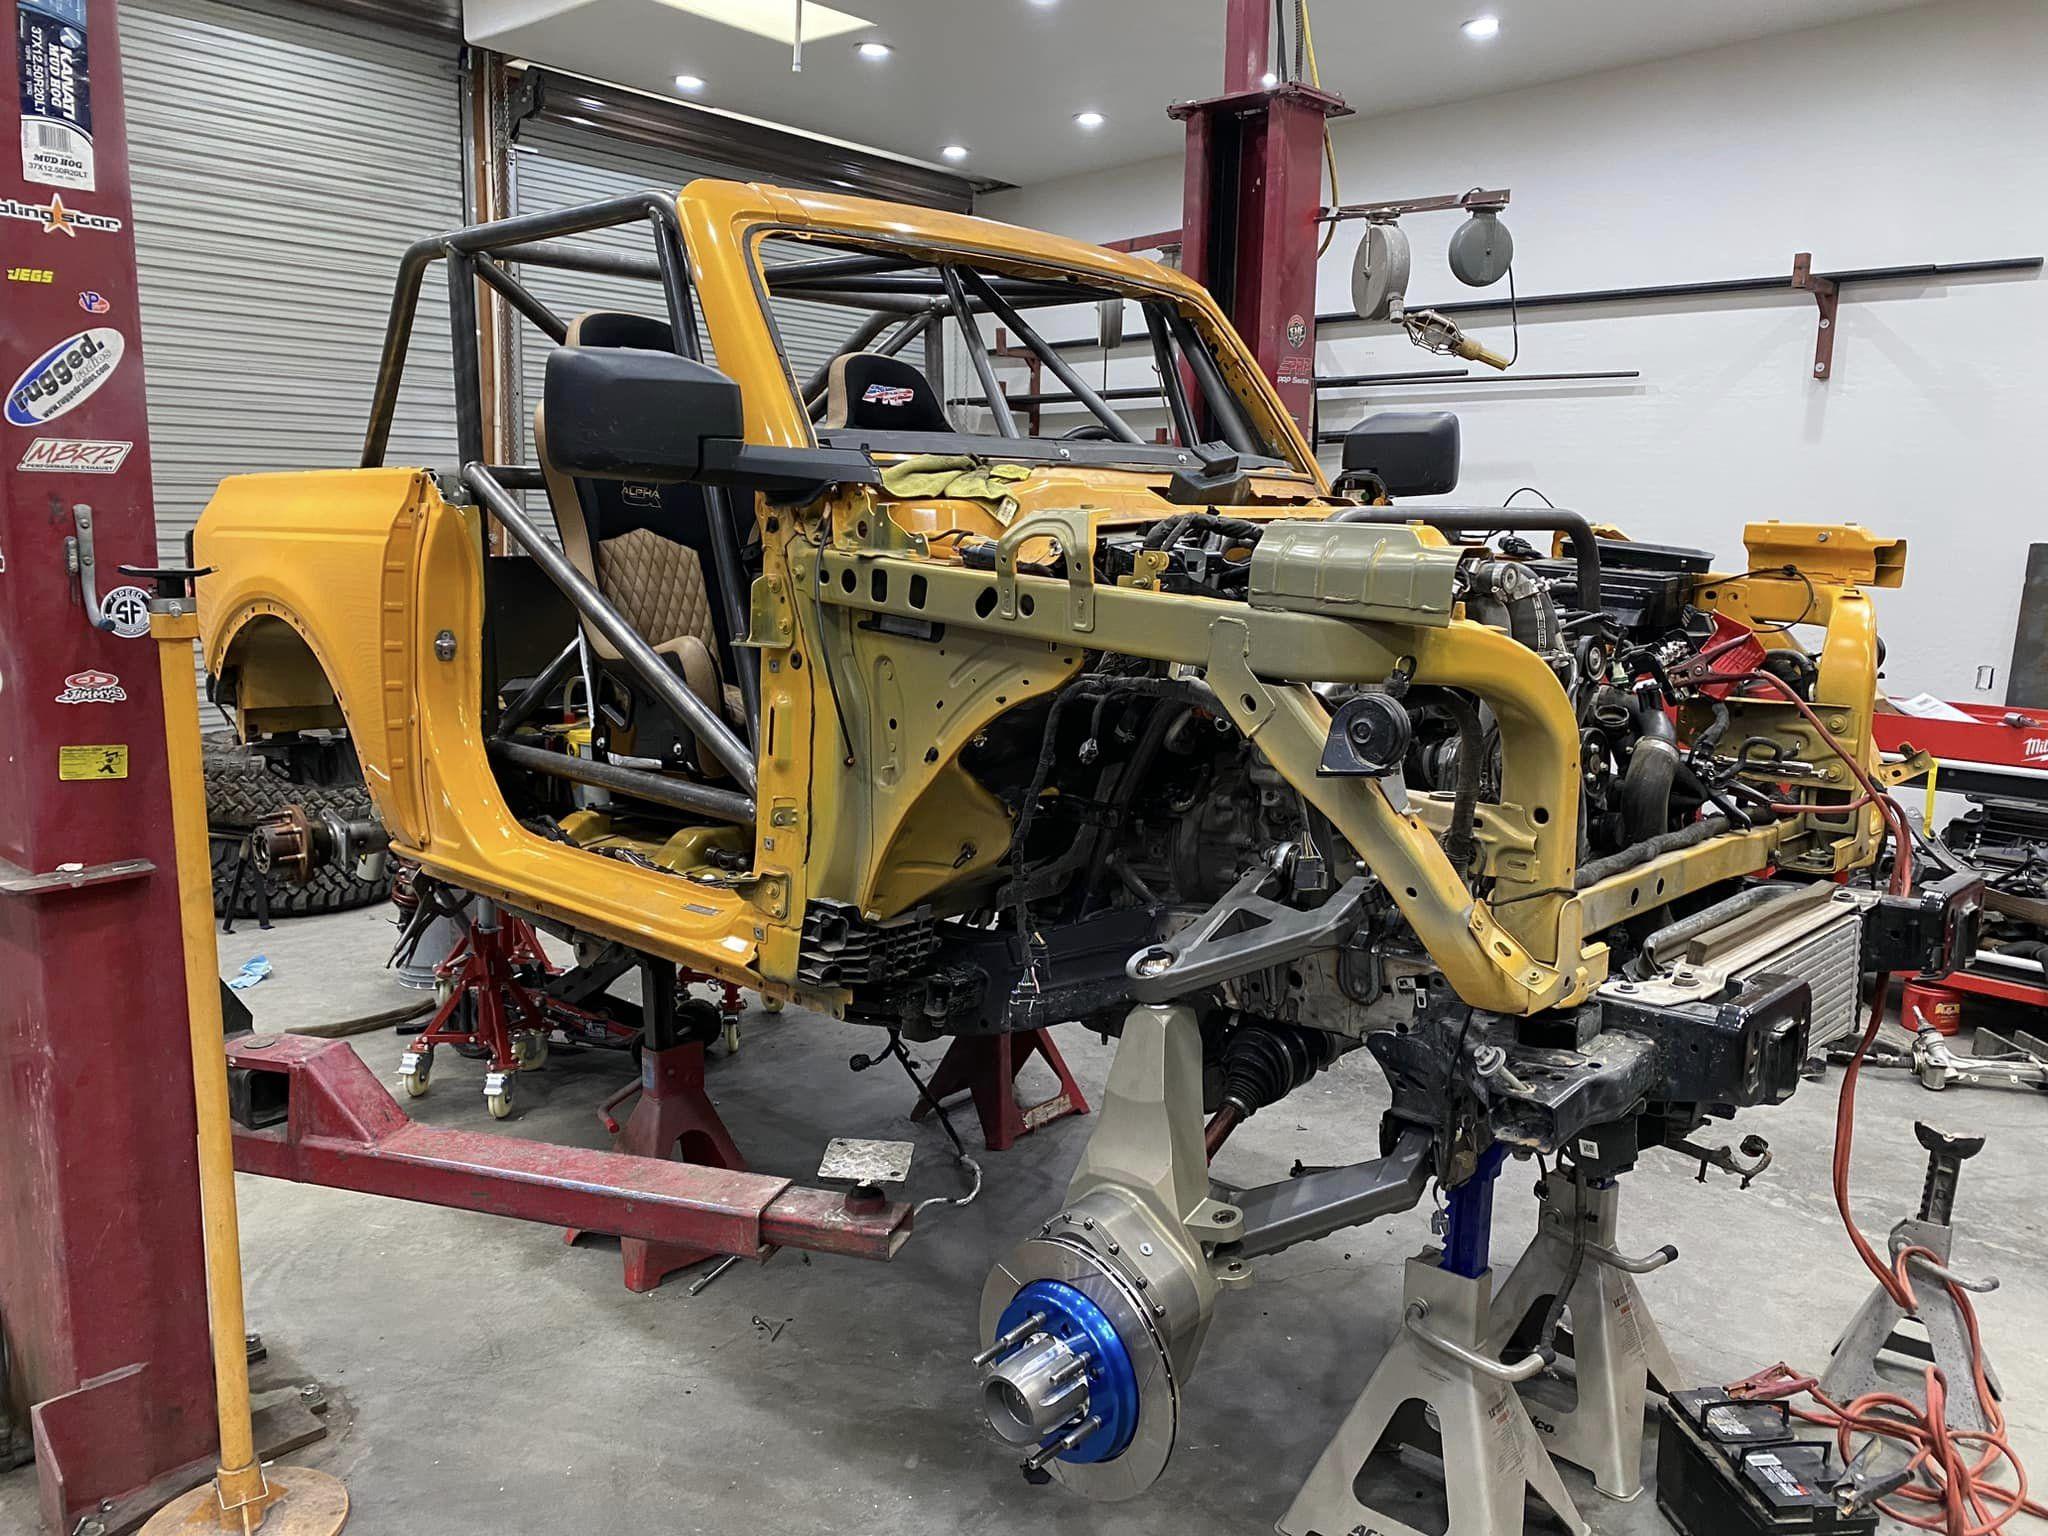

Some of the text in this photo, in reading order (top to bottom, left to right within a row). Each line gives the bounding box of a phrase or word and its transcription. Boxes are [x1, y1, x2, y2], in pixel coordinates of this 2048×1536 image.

[48, 42, 63, 108] MUD HOG
[60, 46, 76, 120] KANATI
[33, 153, 59, 165] MUD
[60, 158, 83, 169] HOG
[7, 268, 54, 283] JEGS
[1277, 375, 1291, 384] PRP
[28, 443, 124, 464] MBRP
[622, 486, 661, 499] ALPHA
